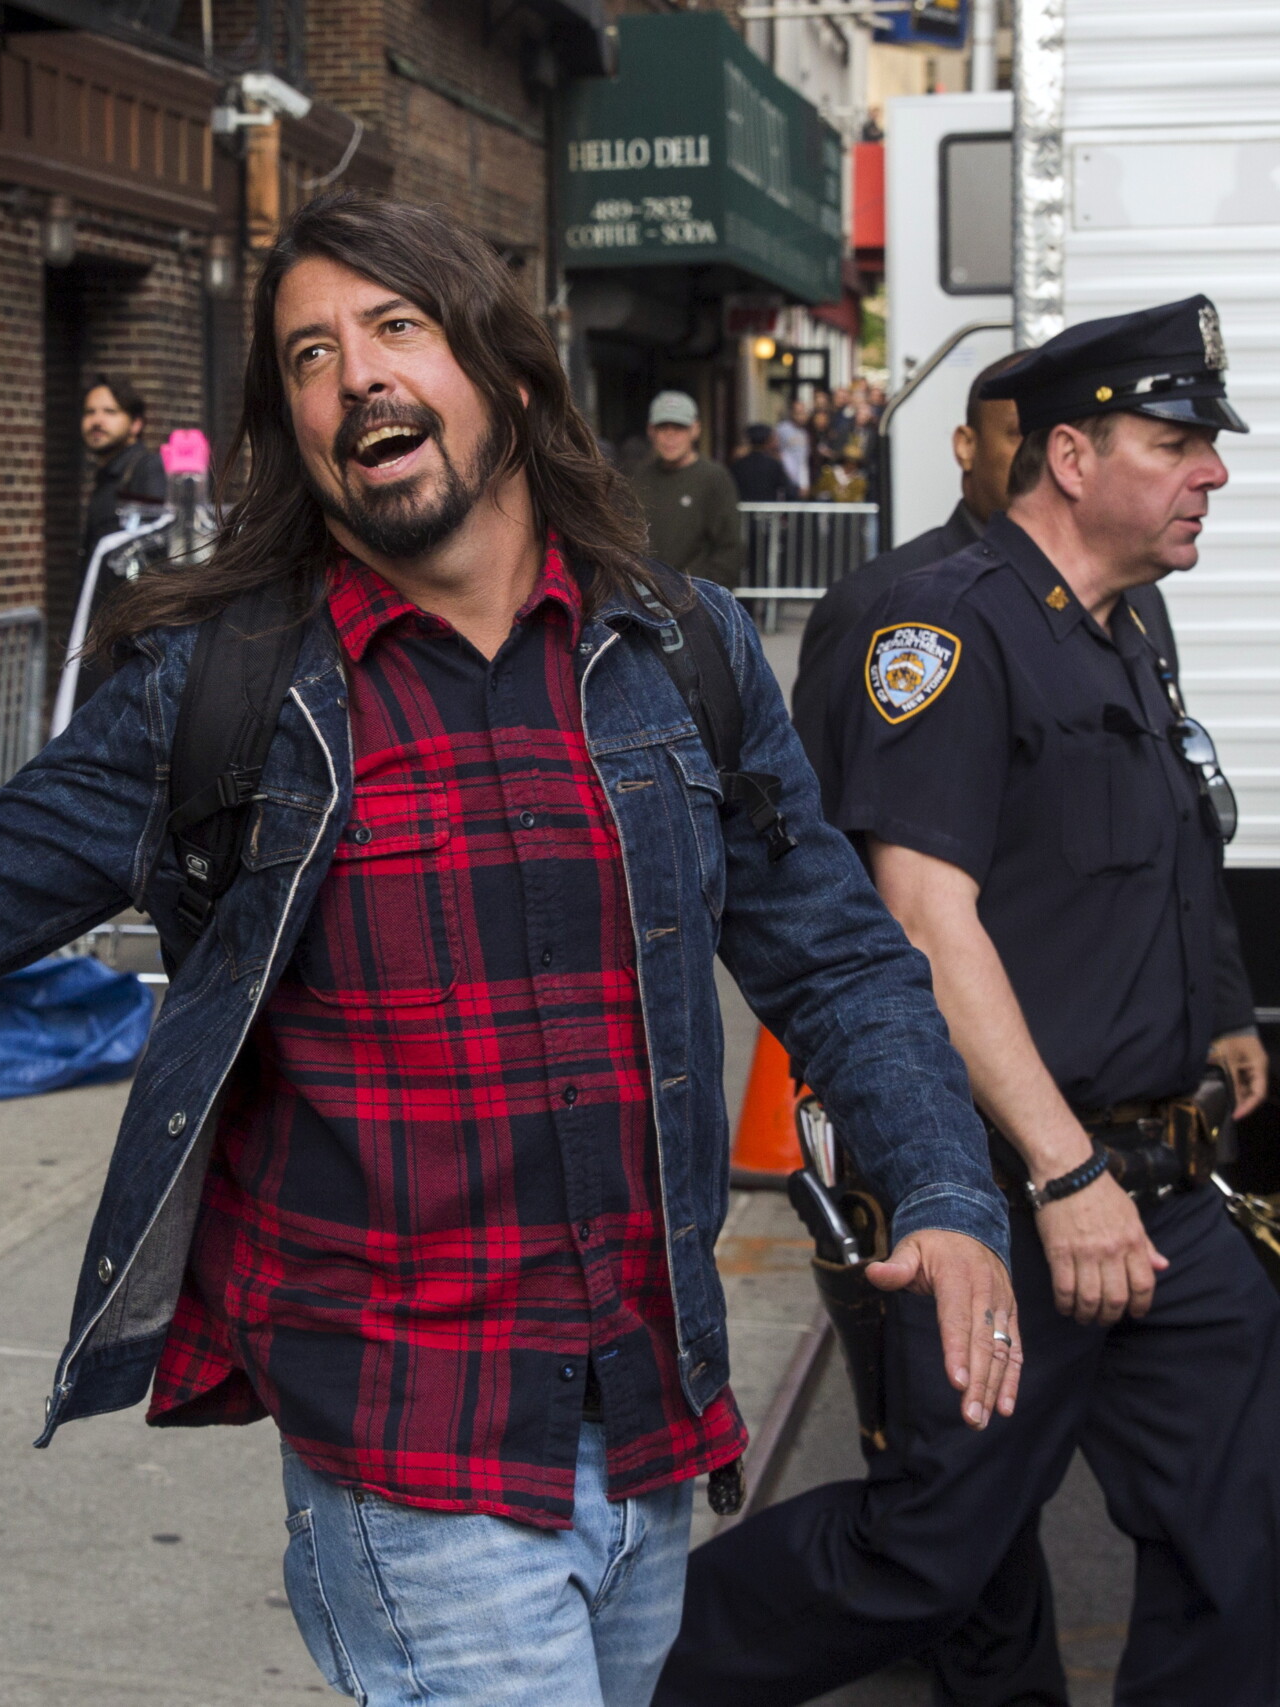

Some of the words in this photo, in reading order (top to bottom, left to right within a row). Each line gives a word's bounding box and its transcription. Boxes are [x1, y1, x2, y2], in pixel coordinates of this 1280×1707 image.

[568, 137, 651, 172] HELLO
[654, 135, 710, 169] DELI
[566, 223, 641, 249] COFFEE
[661, 219, 718, 245] SODA
[876, 638, 952, 661] DEPARTMENT
[893, 628, 939, 644] POLICE
[871, 664, 881, 688] CITY
[877, 688, 889, 703] OF
[901, 693, 926, 712] NEW
[924, 668, 948, 694] YORK
